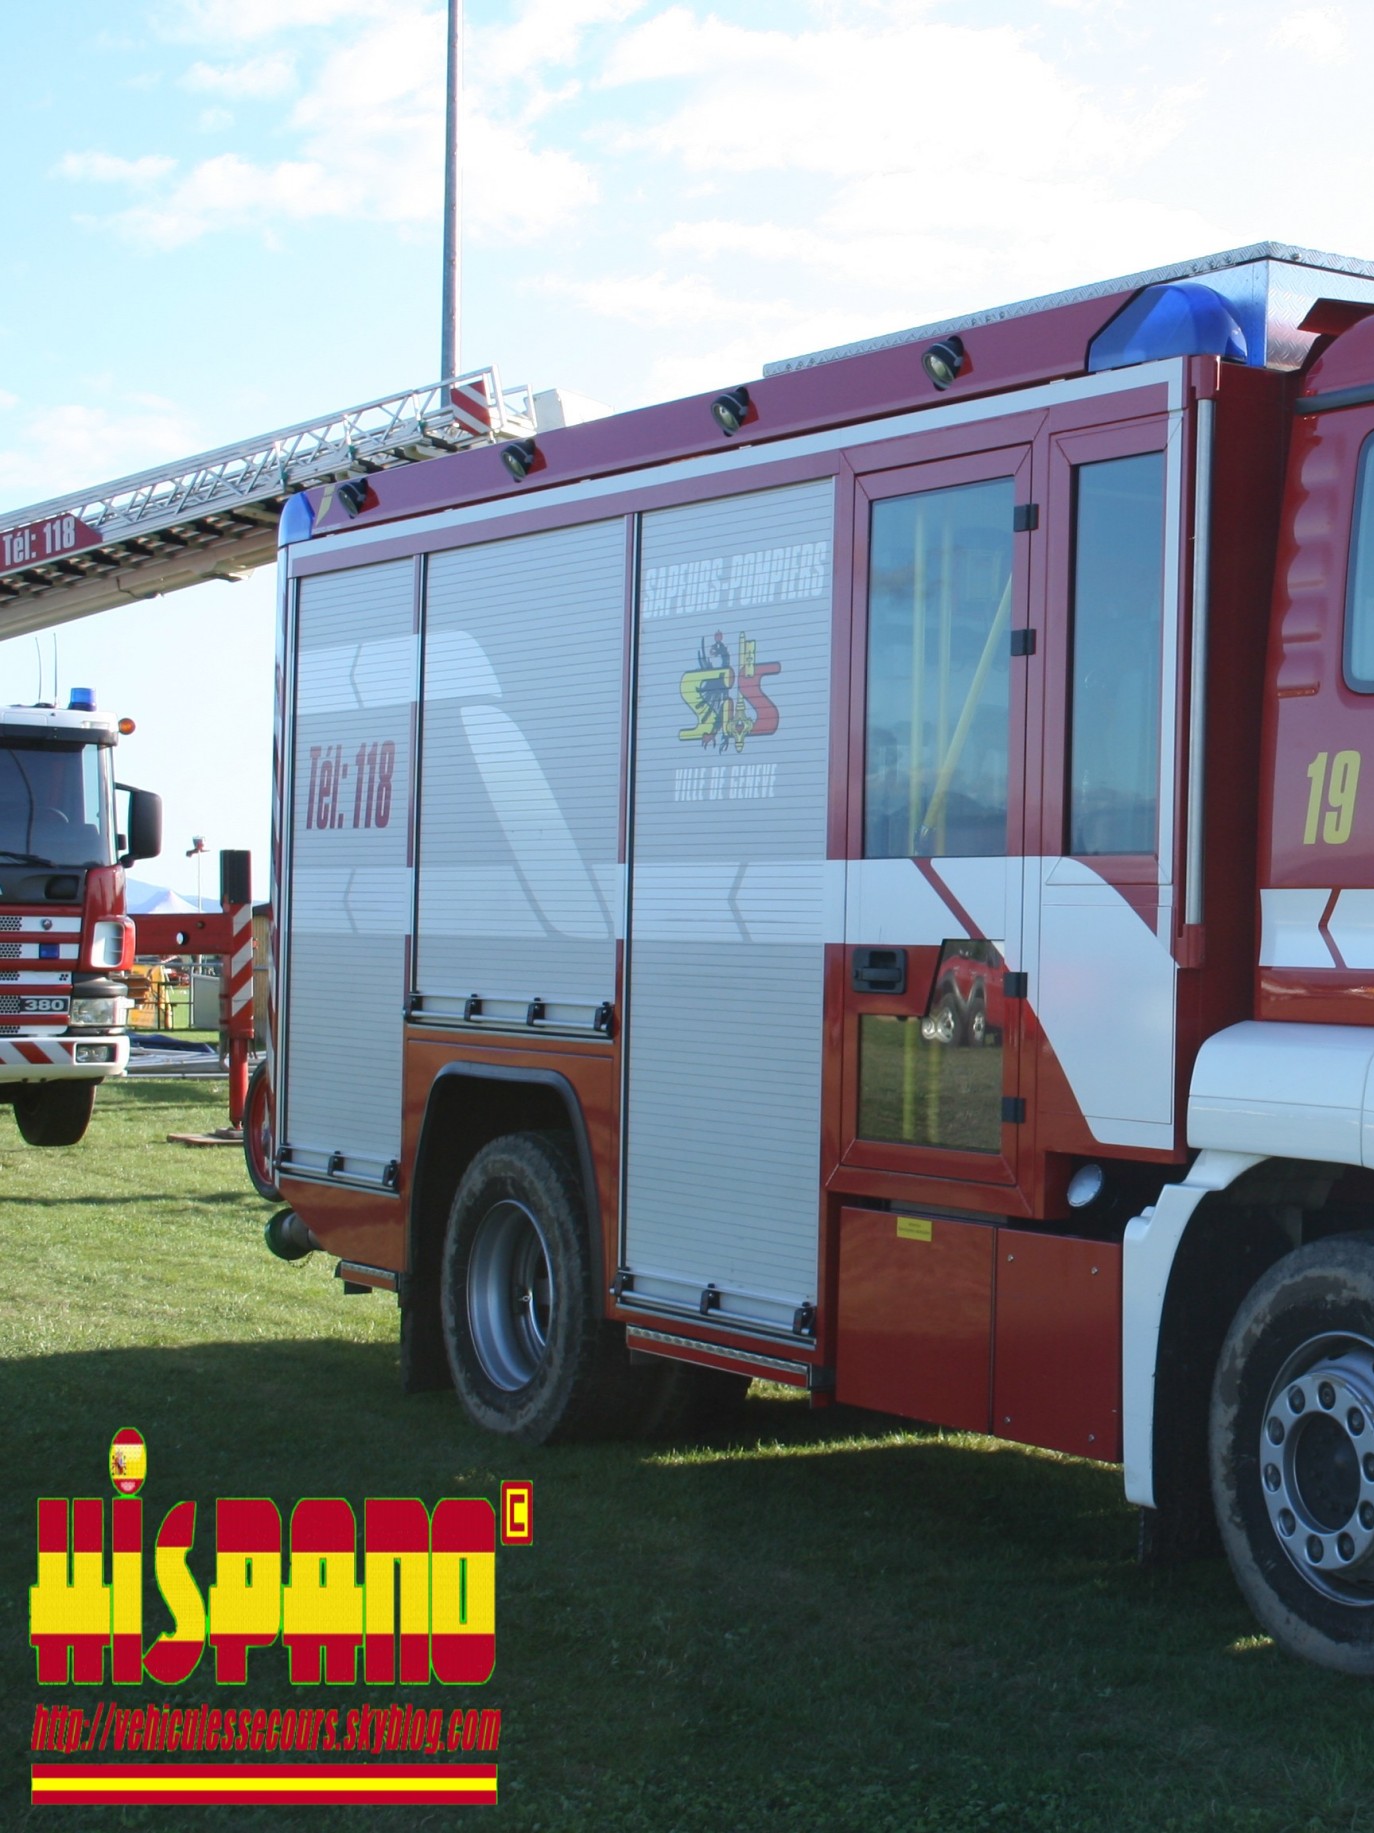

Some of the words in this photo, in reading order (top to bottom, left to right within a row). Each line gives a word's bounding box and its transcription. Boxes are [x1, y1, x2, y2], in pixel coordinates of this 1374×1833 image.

[3, 532, 40, 566] Tél:
[43, 514, 76, 553] 118
[306, 745, 345, 830] Tél:
[353, 739, 396, 830] 118
[674, 767, 706, 801] VILLE
[709, 765, 728, 800] DE
[1303, 750, 1361, 845] 19
[24, 999, 64, 1012] 380
